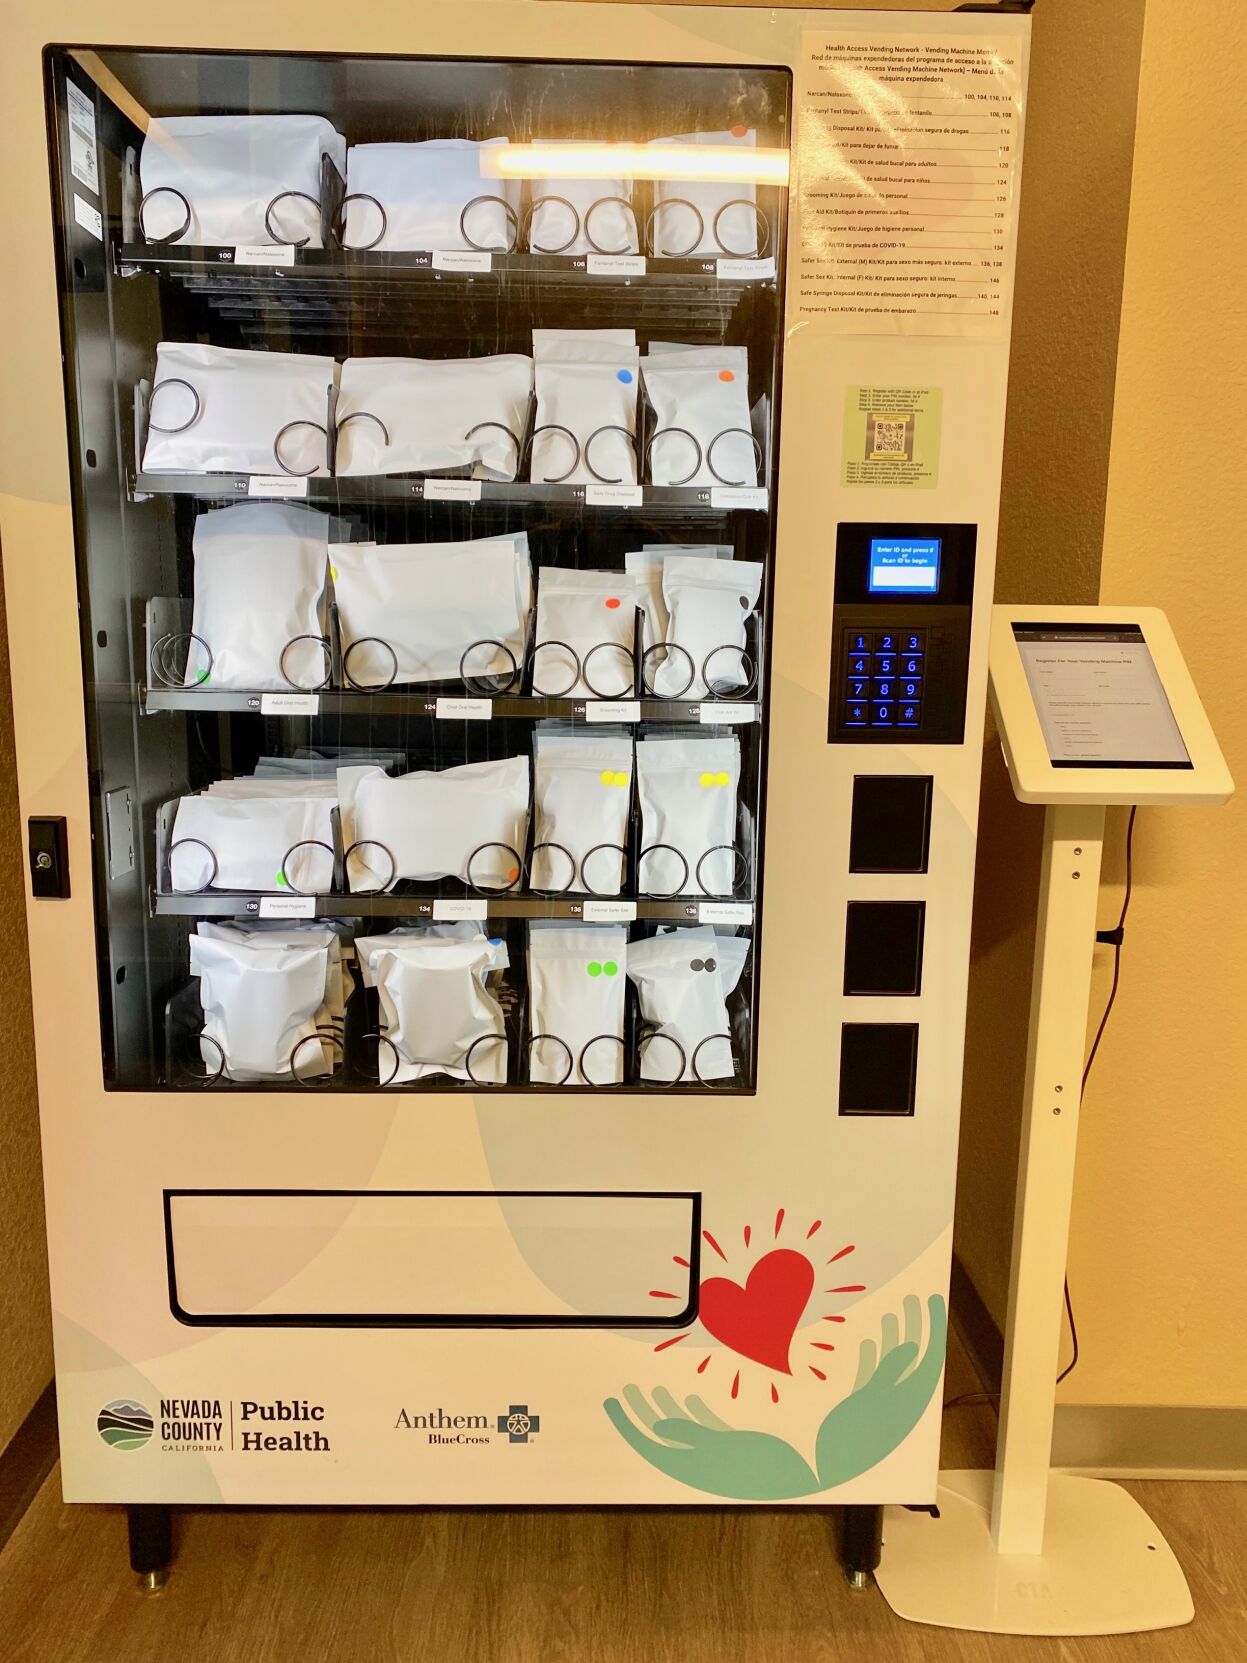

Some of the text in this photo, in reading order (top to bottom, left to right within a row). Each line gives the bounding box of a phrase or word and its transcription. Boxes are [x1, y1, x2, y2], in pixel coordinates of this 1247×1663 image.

[857, 637, 917, 649] 1 2 3
[855, 660, 916, 672] 4 5 6
[855, 684, 915, 695] 7 8 9
[879, 707, 914, 718] 0 #
[160, 1400, 222, 1419] NEVADA
[241, 1401, 324, 1421] Public
[393, 1408, 489, 1429] Anthem
[161, 1422, 222, 1441] COUNTY
[241, 1431, 331, 1451] Health
[428, 1433, 490, 1445] BlueCross
[162, 1444, 224, 1452] CALIFORNIA
